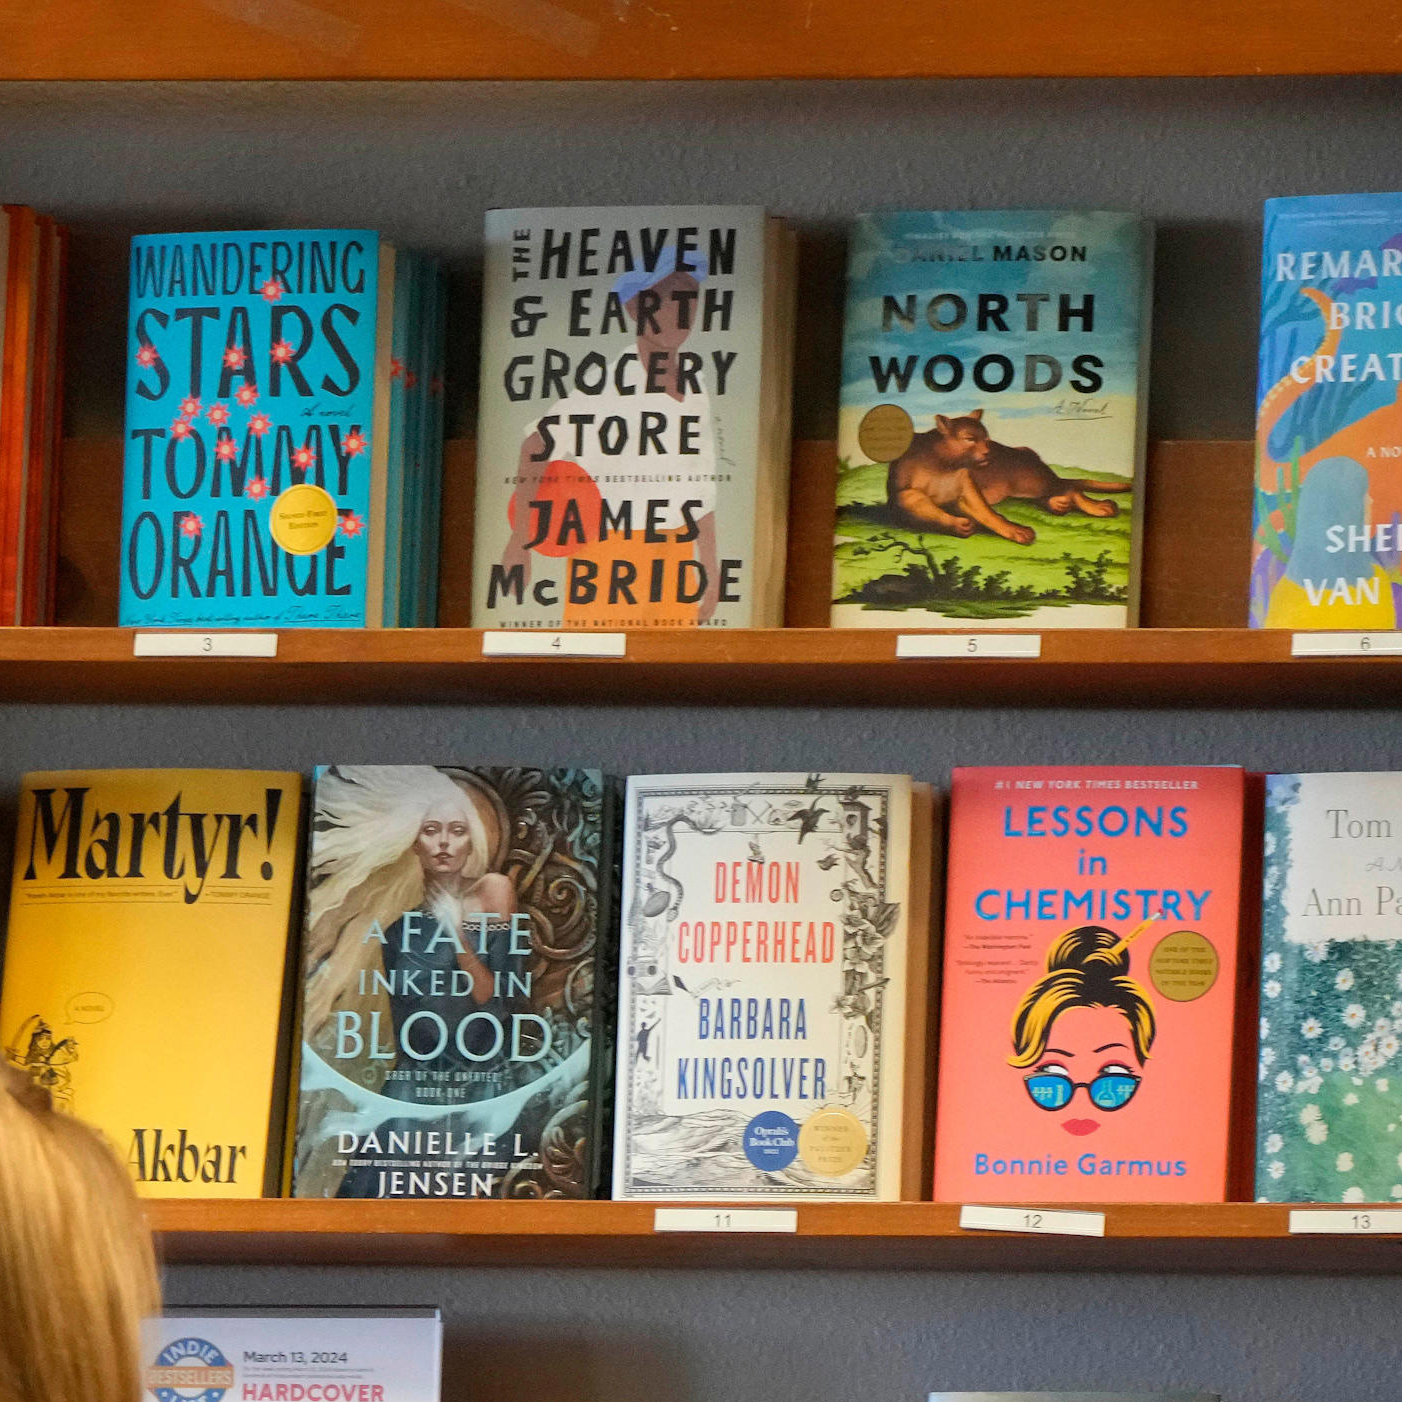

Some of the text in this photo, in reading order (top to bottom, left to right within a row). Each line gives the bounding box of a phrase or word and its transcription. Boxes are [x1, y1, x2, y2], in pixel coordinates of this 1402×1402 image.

[136, 241, 365, 298] WANDERING
[540, 227, 736, 280] HEAVEN
[511, 288, 732, 337] & EARTH
[881, 294, 1095, 333] NORTH
[134, 304, 360, 400] STARS
[503, 350, 737, 402] GROCERY
[869, 354, 1104, 394] WOODS
[529, 412, 701, 462] STORE
[522, 499, 703, 550] JAMES
[486, 559, 743, 610] McBRIDE
[1014, 780, 1042, 790] NEW
[1046, 779, 1081, 789] YORK
[1083, 779, 1121, 789] TIMES
[1124, 779, 1199, 790] BESTSELLER
[1003, 806, 1188, 838] LESSONS
[1326, 808, 1394, 839] Tom
[23, 787, 282, 905] Martyr!
[1077, 848, 1107, 876] in
[714, 861, 800, 904] DEMON
[1302, 888, 1363, 917] Ann
[974, 889, 1212, 922] CHEMISTRY
[678, 922, 835, 963] COPPERHEAD
[359, 969, 533, 999] INKED IN
[334, 1011, 552, 1063] BLOOD
[698, 998, 808, 1040] BARBARA
[677, 1057, 827, 1100] KINGSOLVER
[974, 1153, 1187, 1177] Bonnie Garmus
[714, 1214, 731, 1228] 11
[1023, 1215, 1042, 1229] 12
[1351, 1214, 1371, 1230] 13
[244, 1351, 348, 1366] March 13, 2024
[242, 1383, 384, 1402] HARDCOVER
